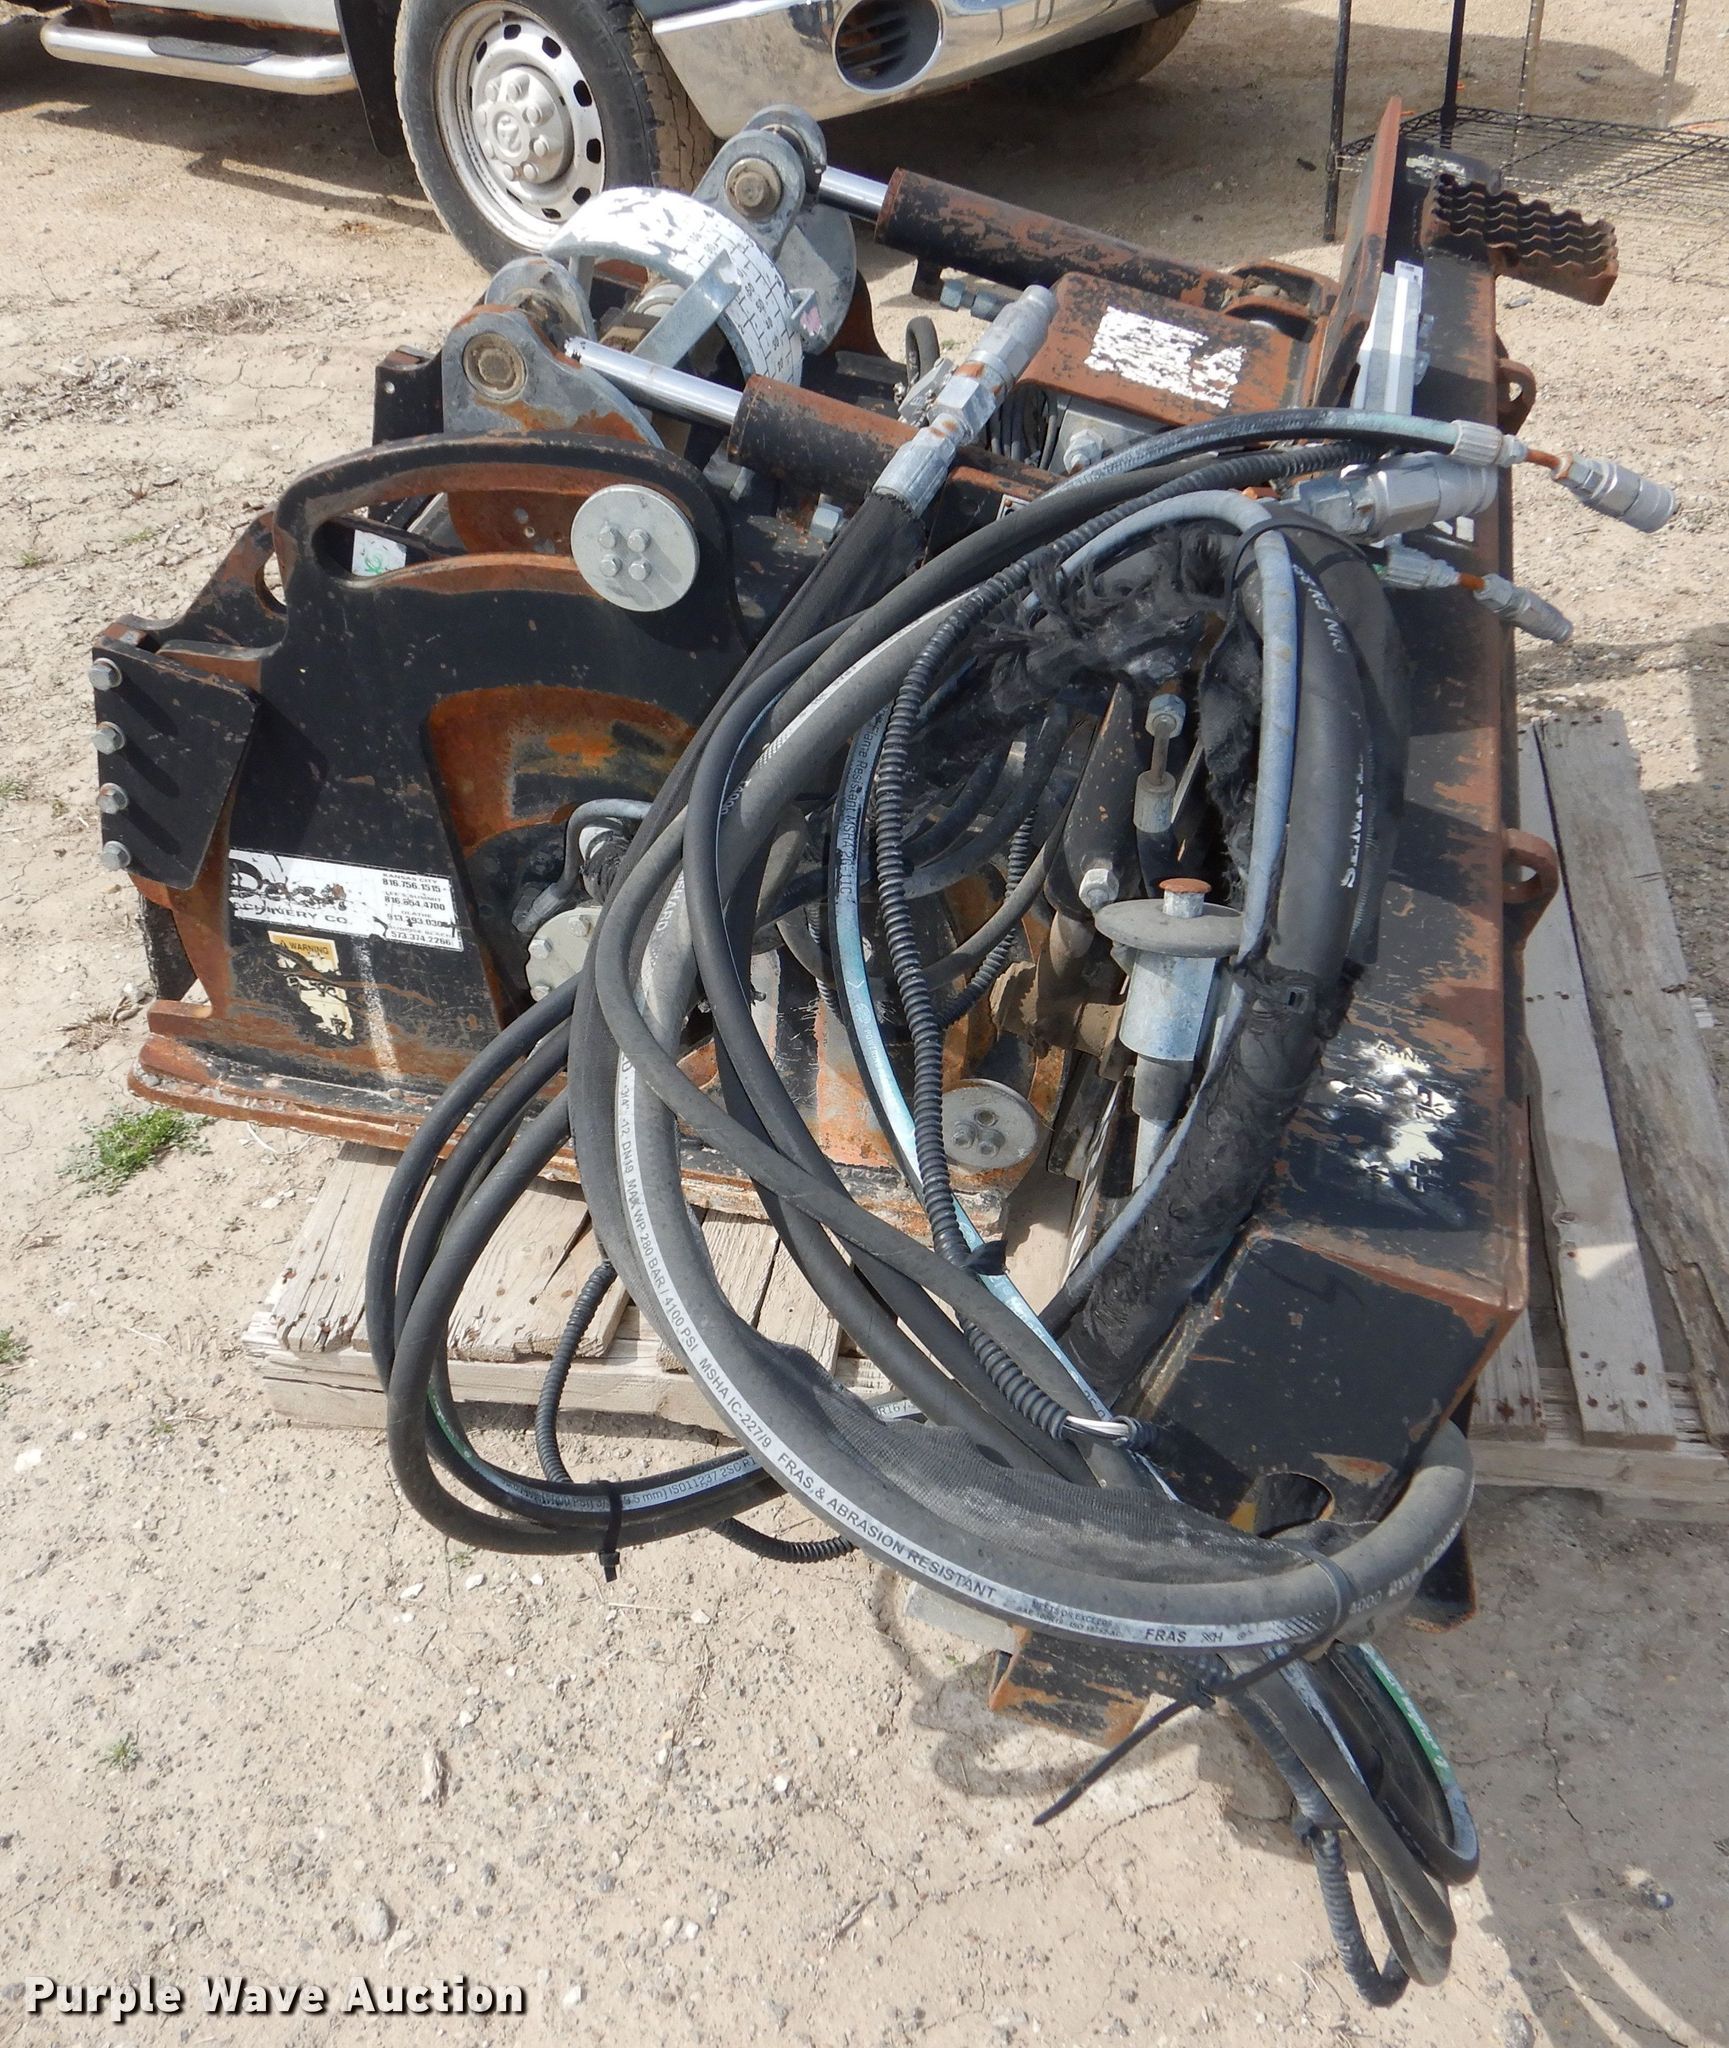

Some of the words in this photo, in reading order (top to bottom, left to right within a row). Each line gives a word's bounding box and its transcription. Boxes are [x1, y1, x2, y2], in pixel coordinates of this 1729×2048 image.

[382, 878, 442, 893] 816.756.1515
[289, 942, 330, 956] WARNING
[621, 1140, 635, 1175] DN19
[625, 1178, 642, 1209] MAX
[633, 1208, 647, 1233] WP
[639, 1232, 655, 1258] 280
[648, 1257, 667, 1290] BAR
[664, 1296, 686, 1329] 4100
[680, 1328, 699, 1353] PSI
[699, 1357, 730, 1400] MSHA
[727, 1396, 773, 1449] IC-227/9
[777, 1451, 815, 1490] FRAS
[814, 1486, 827, 1500] &
[827, 1497, 907, 1557] ABRASION
[906, 1550, 998, 1601] RESISTANT
[1144, 1627, 1188, 1644] FRAS
